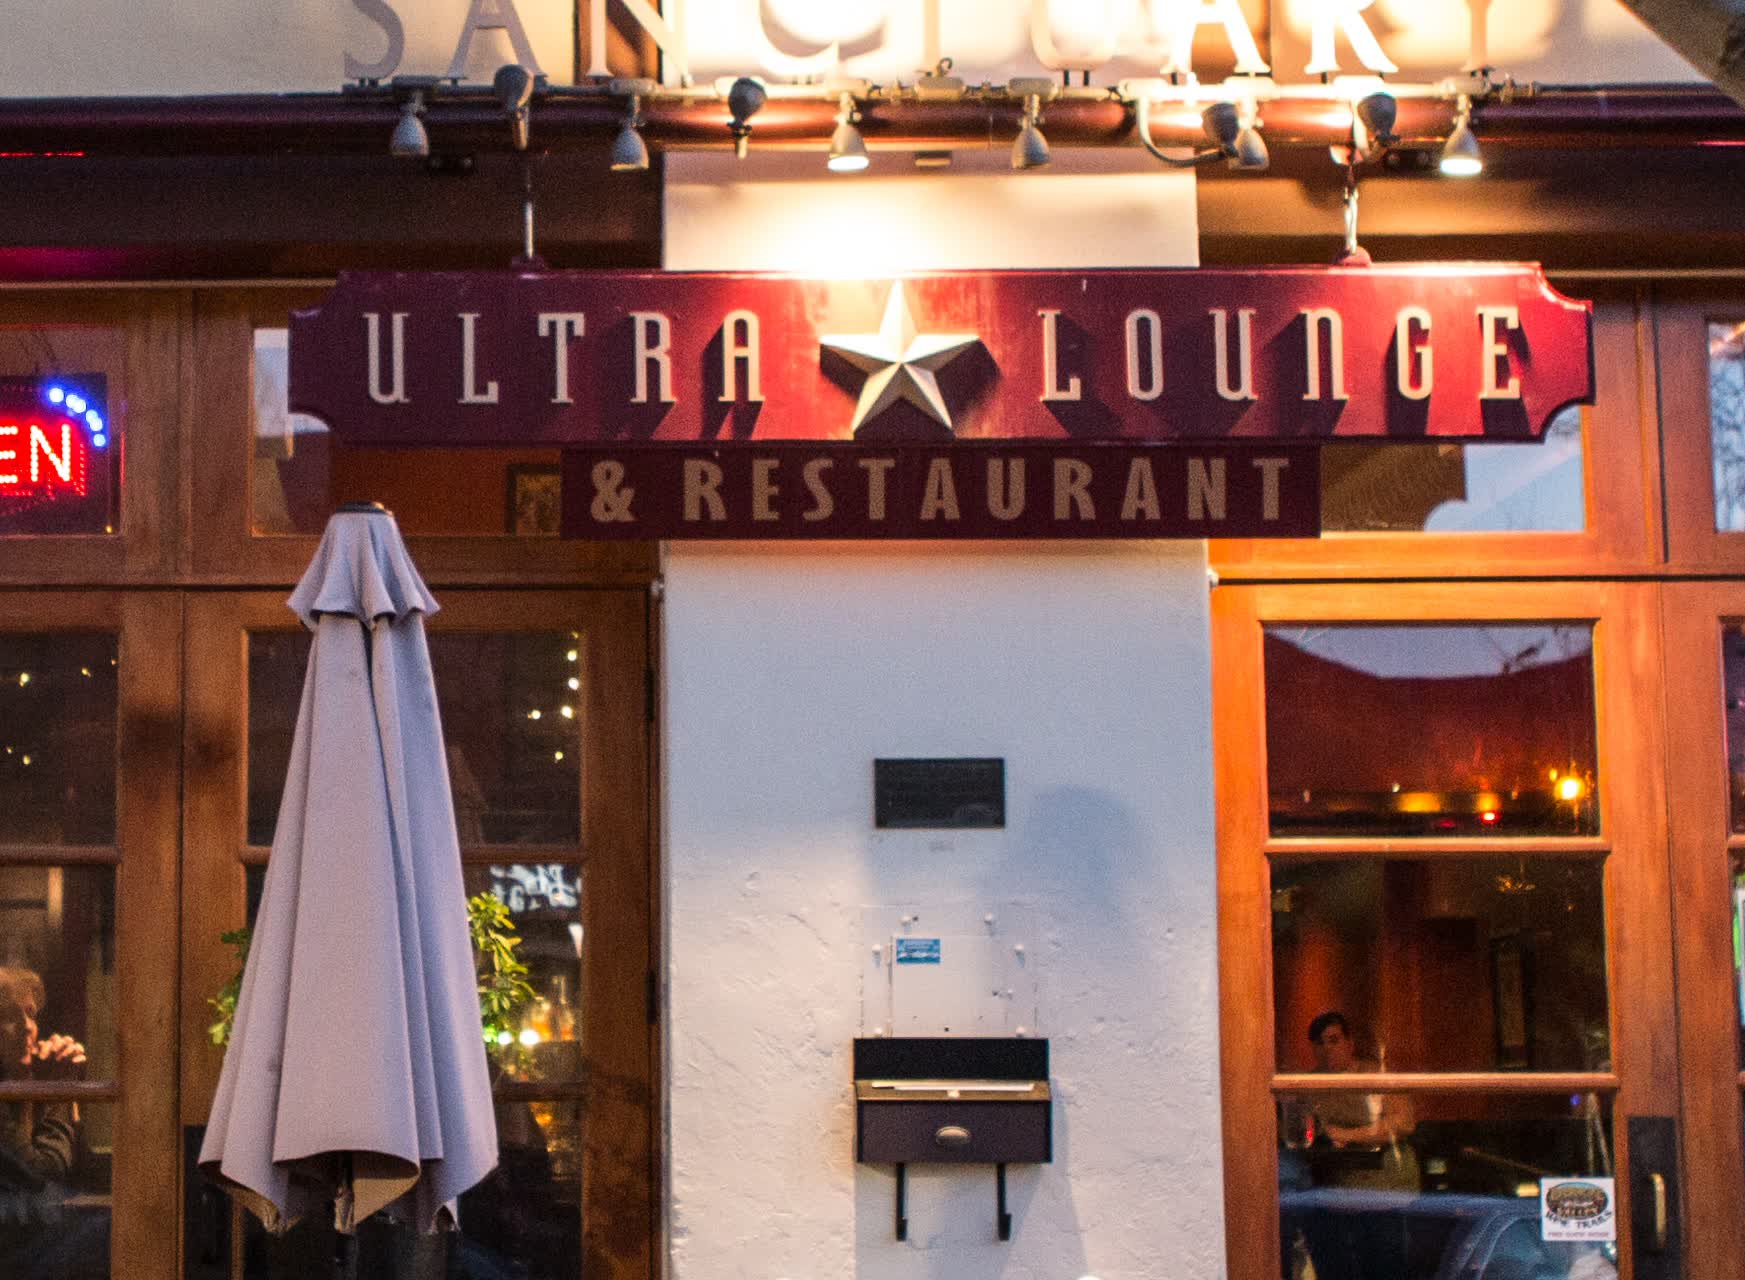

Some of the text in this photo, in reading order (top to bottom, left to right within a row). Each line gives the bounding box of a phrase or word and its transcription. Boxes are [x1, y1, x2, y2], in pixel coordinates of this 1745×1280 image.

[363, 306, 1522, 405] ULTRA LOUNGE
[590, 457, 1290, 522] & RESTAURANT
